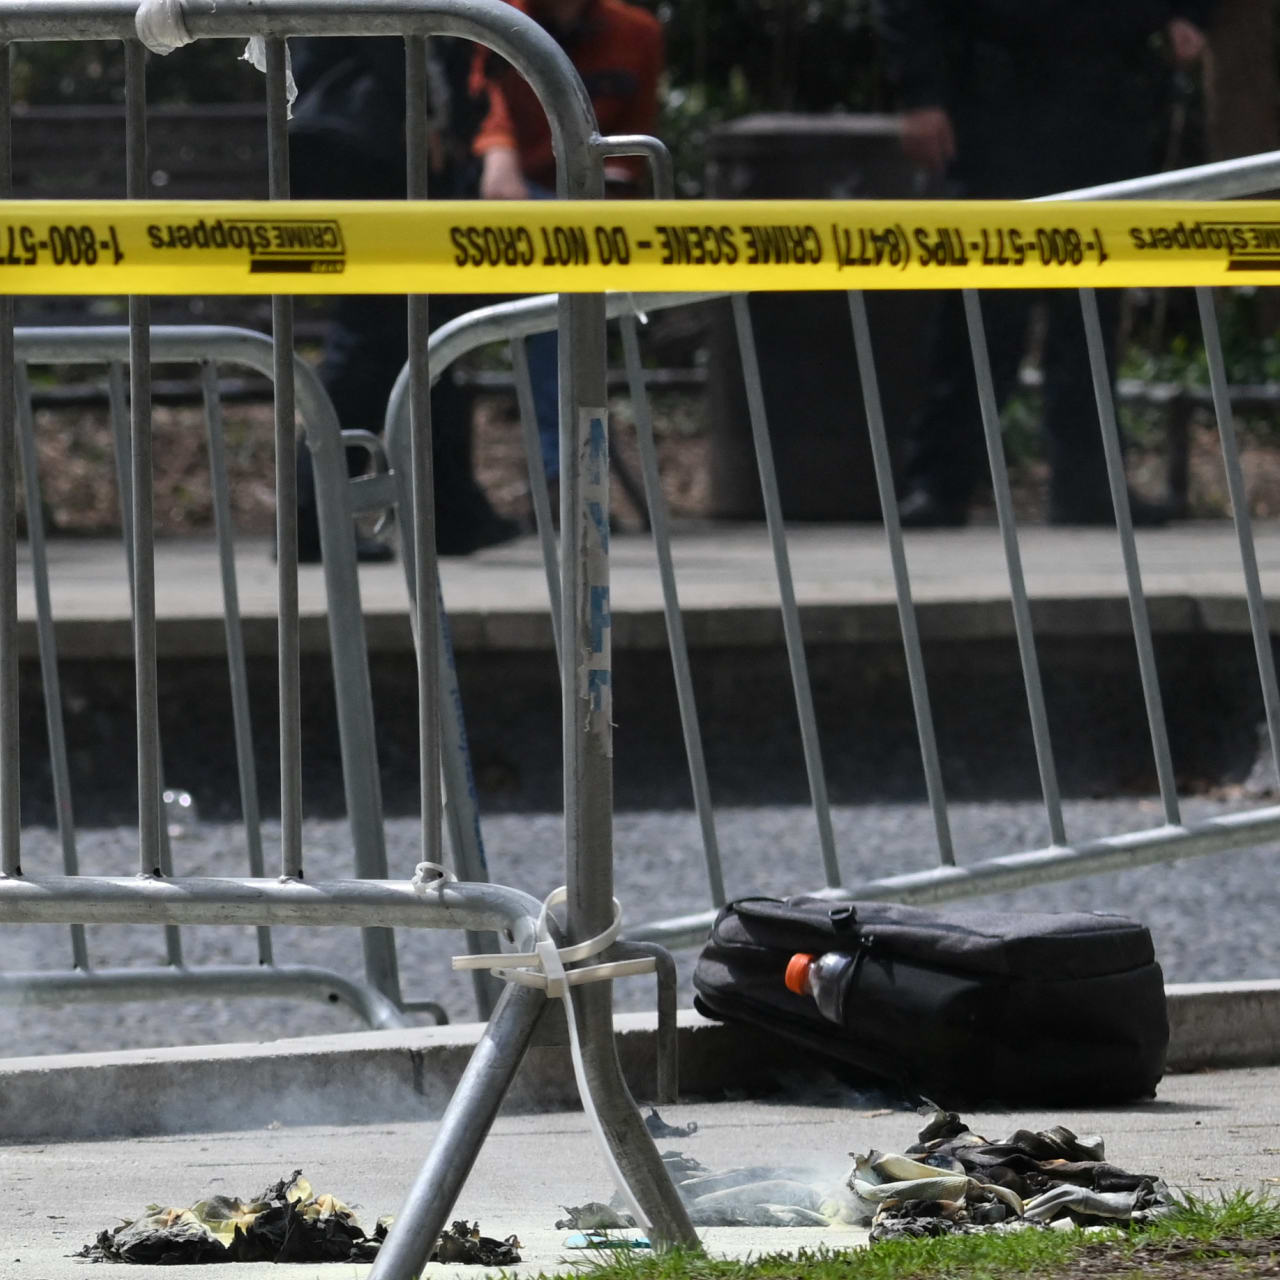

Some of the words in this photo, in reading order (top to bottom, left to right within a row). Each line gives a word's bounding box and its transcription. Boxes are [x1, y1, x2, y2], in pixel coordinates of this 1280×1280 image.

[449, 226, 536, 266] CROSS
[540, 226, 590, 266] NOT
[594, 226, 631, 265] DO
[654, 226, 739, 265] SCENE
[740, 225, 823, 264] CRIME
[833, 224, 911, 266] (8477)
[913, 228, 1109, 265] 1-800-577-TIPS
